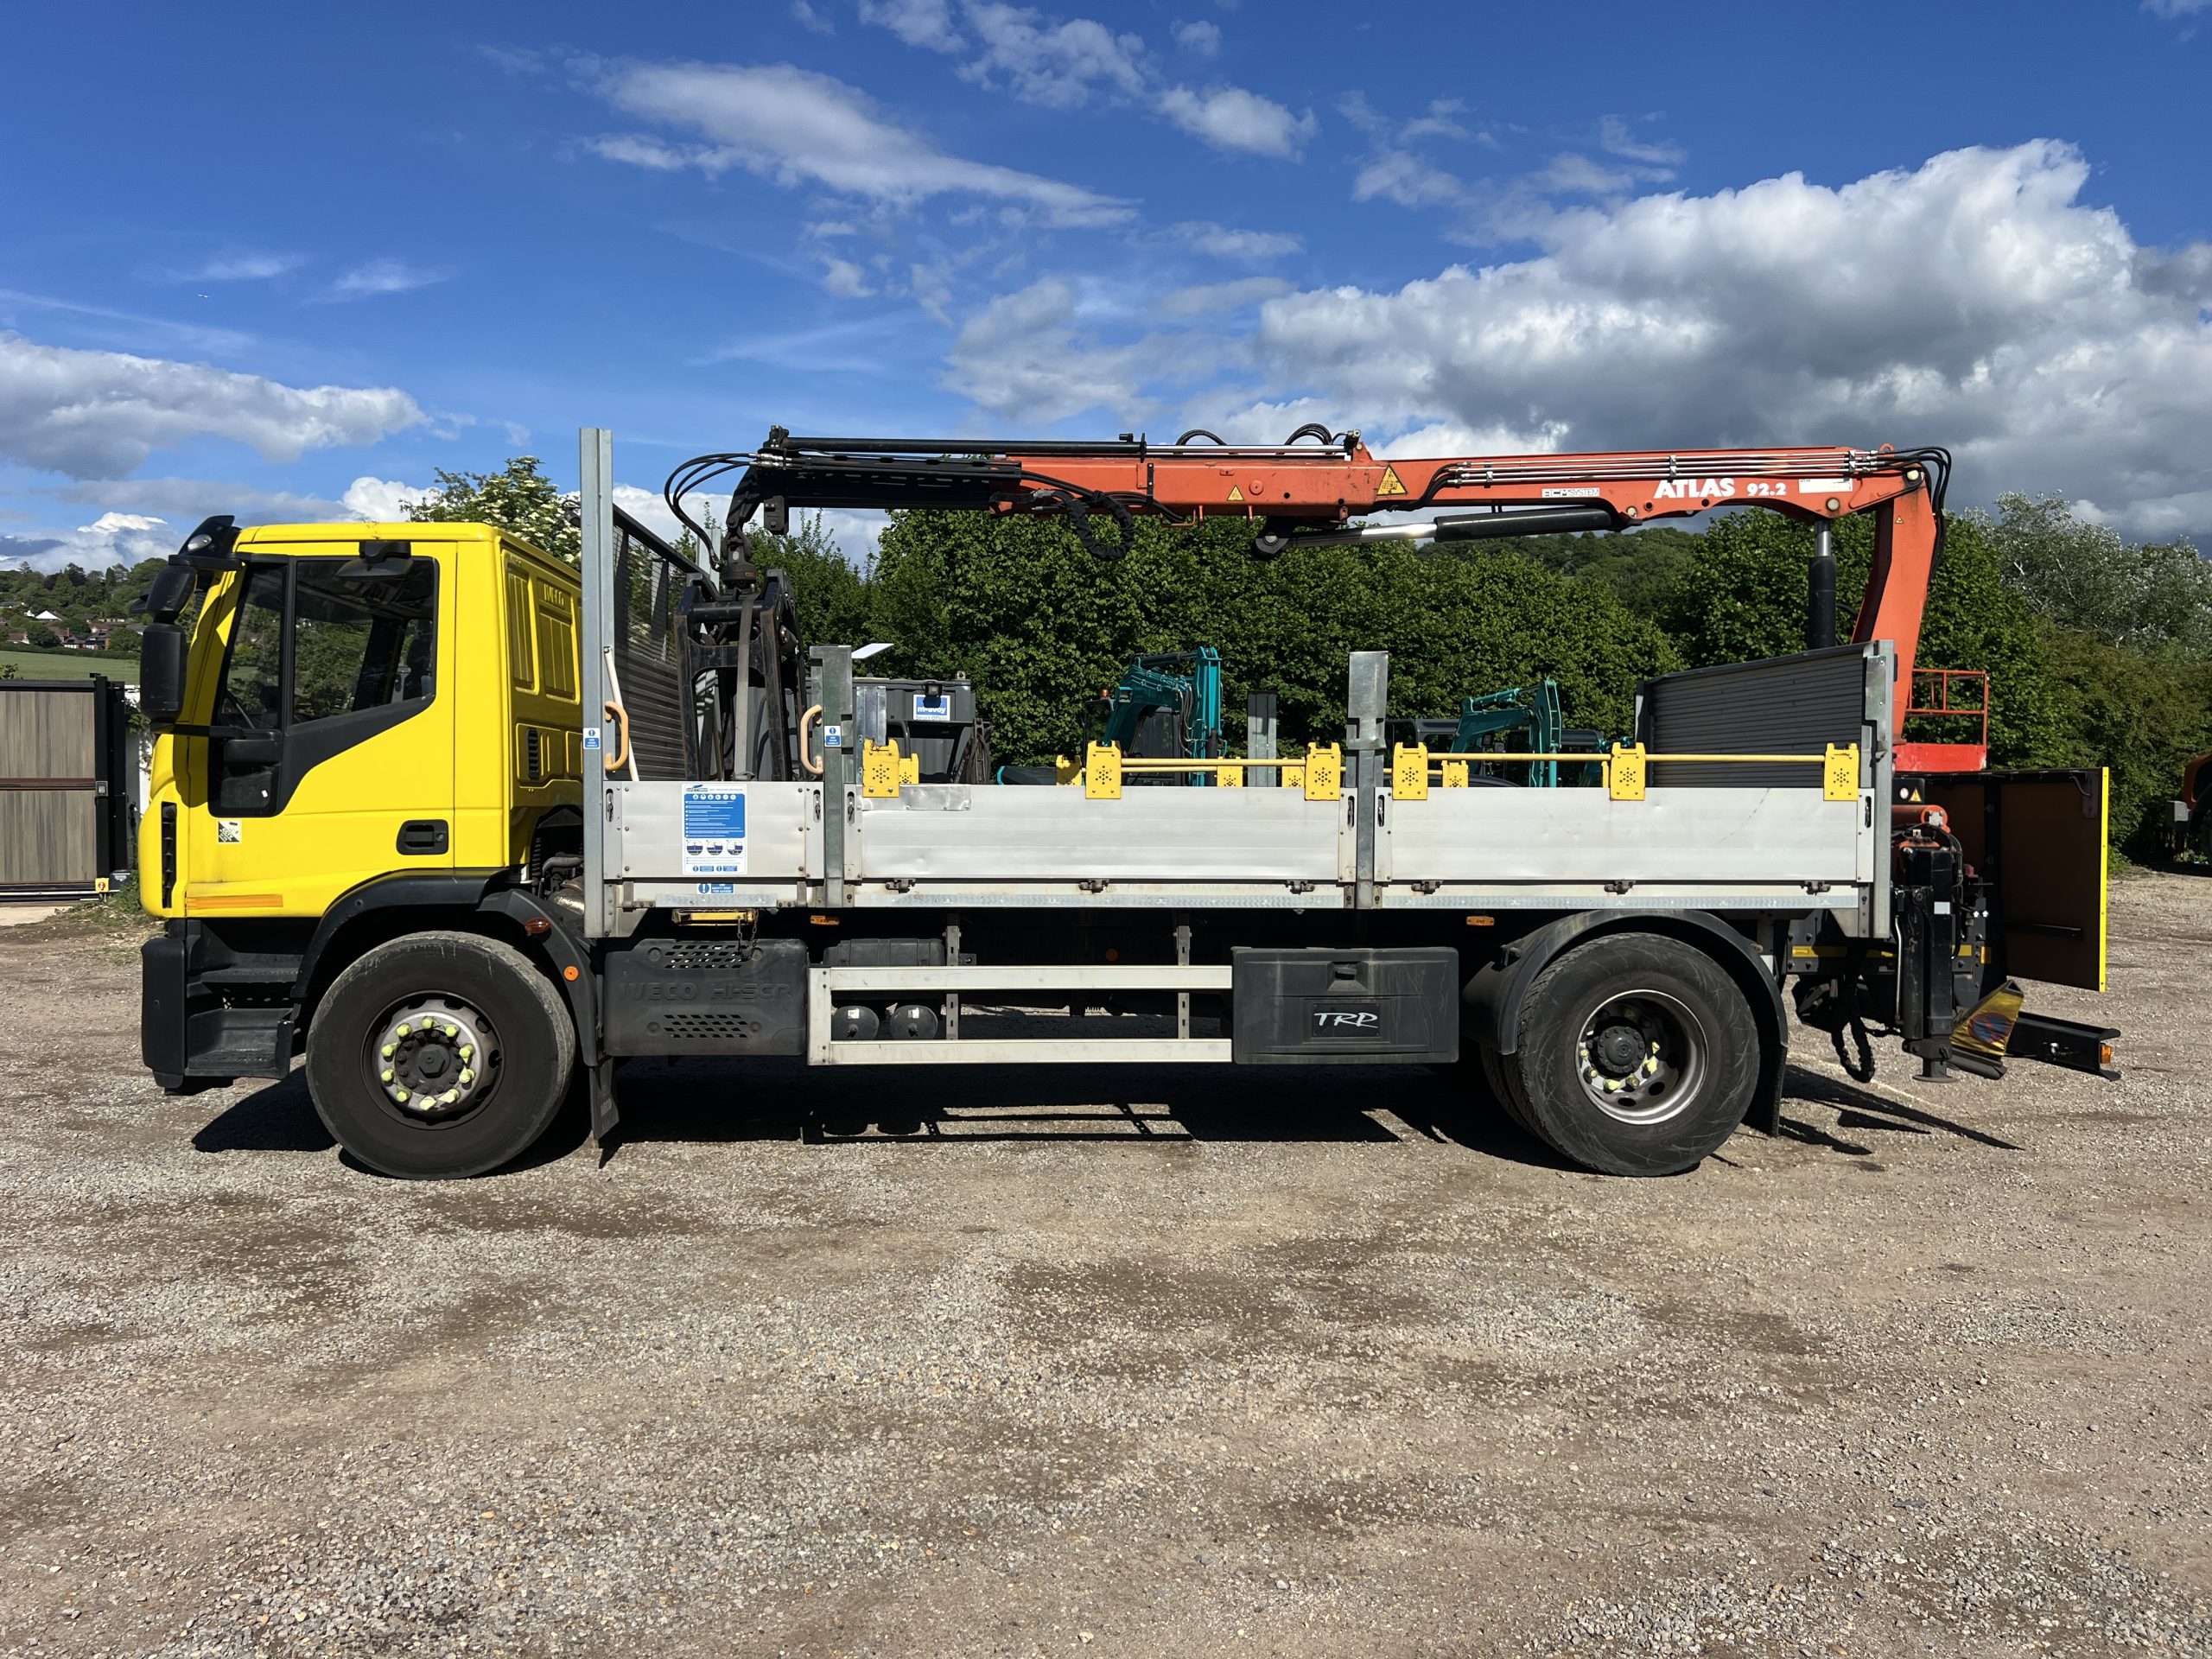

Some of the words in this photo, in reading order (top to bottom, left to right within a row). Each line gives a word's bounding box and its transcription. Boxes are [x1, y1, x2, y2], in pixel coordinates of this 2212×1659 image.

[1653, 478, 1736, 499] ATLAS
[1746, 482, 1787, 497] 92.2
[618, 982, 698, 1001] IVECO
[709, 982, 792, 1000] HI-SCR
[1313, 1012, 1379, 1029] TRP
